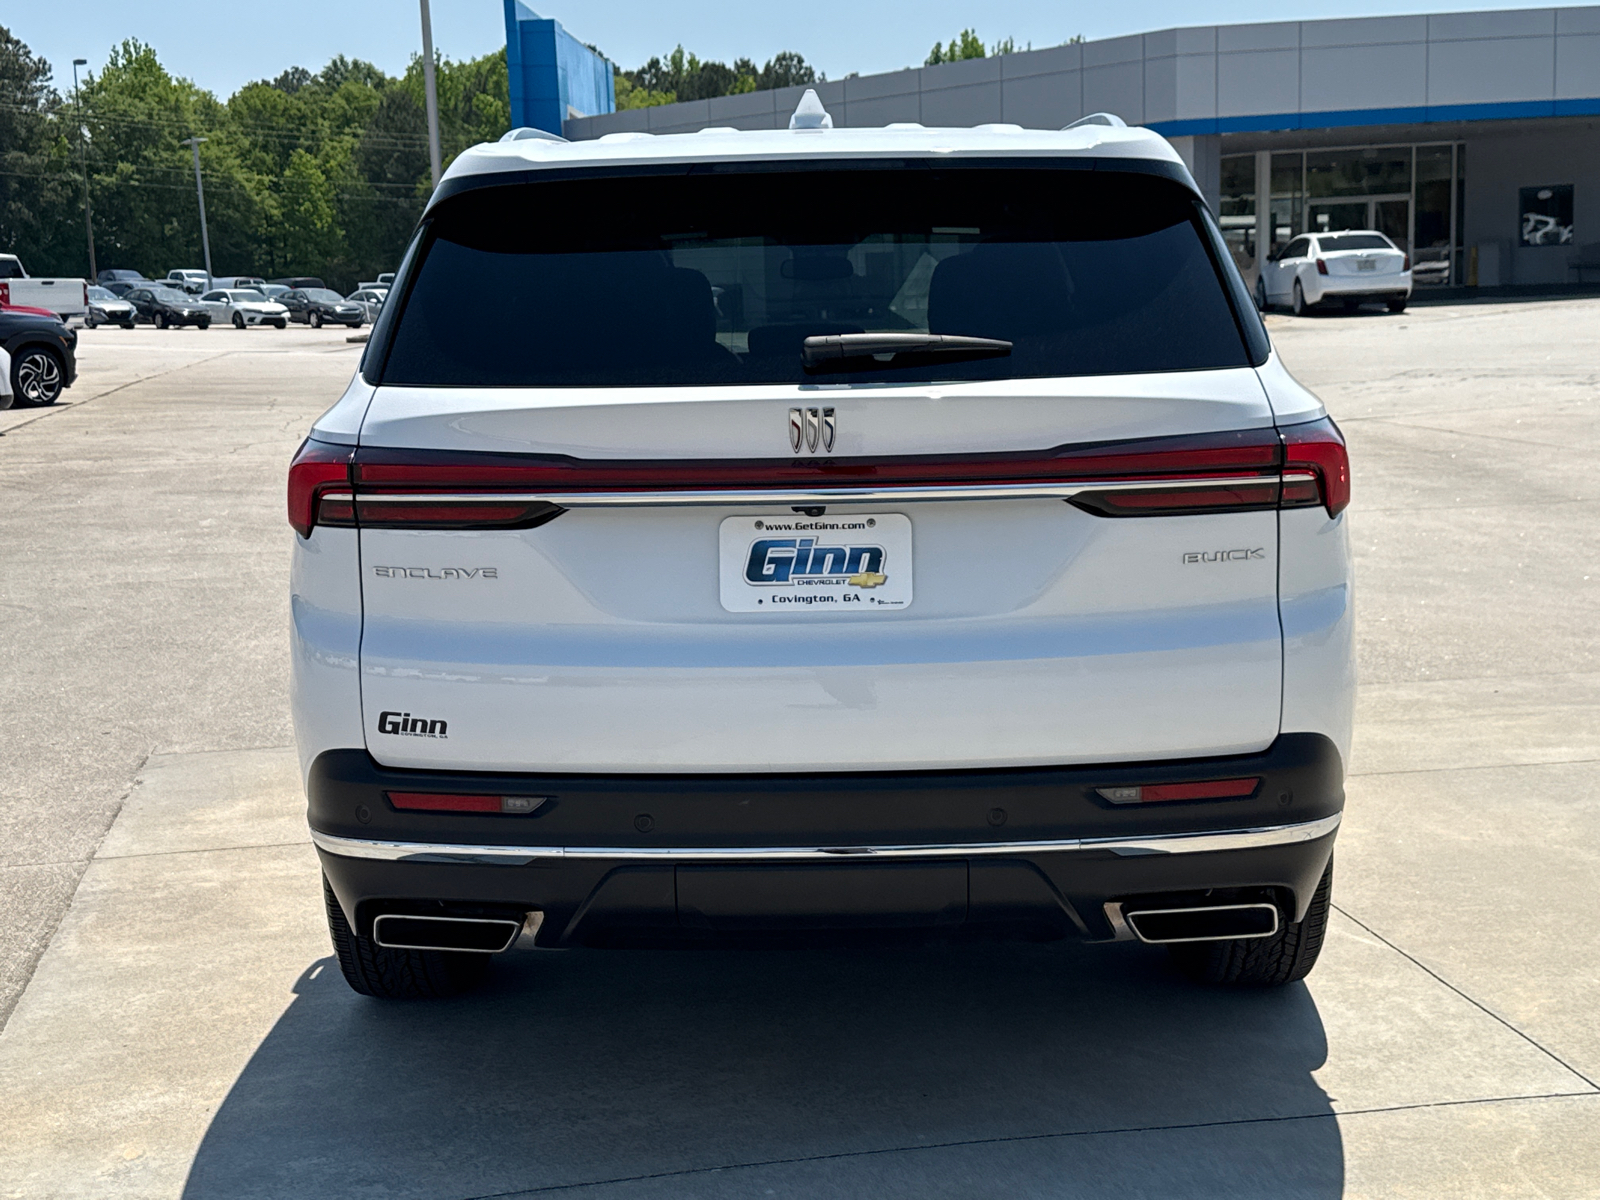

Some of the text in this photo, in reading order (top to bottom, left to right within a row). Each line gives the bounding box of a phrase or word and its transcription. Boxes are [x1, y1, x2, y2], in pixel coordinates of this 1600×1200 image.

[765, 521, 865, 531] www.GetGinn.com
[744, 537, 885, 584] Ginn
[1182, 548, 1266, 564] BUICK
[372, 565, 498, 579] ENCLAVE
[771, 594, 861, 604] Covington, GA
[377, 711, 448, 735] Ginn
